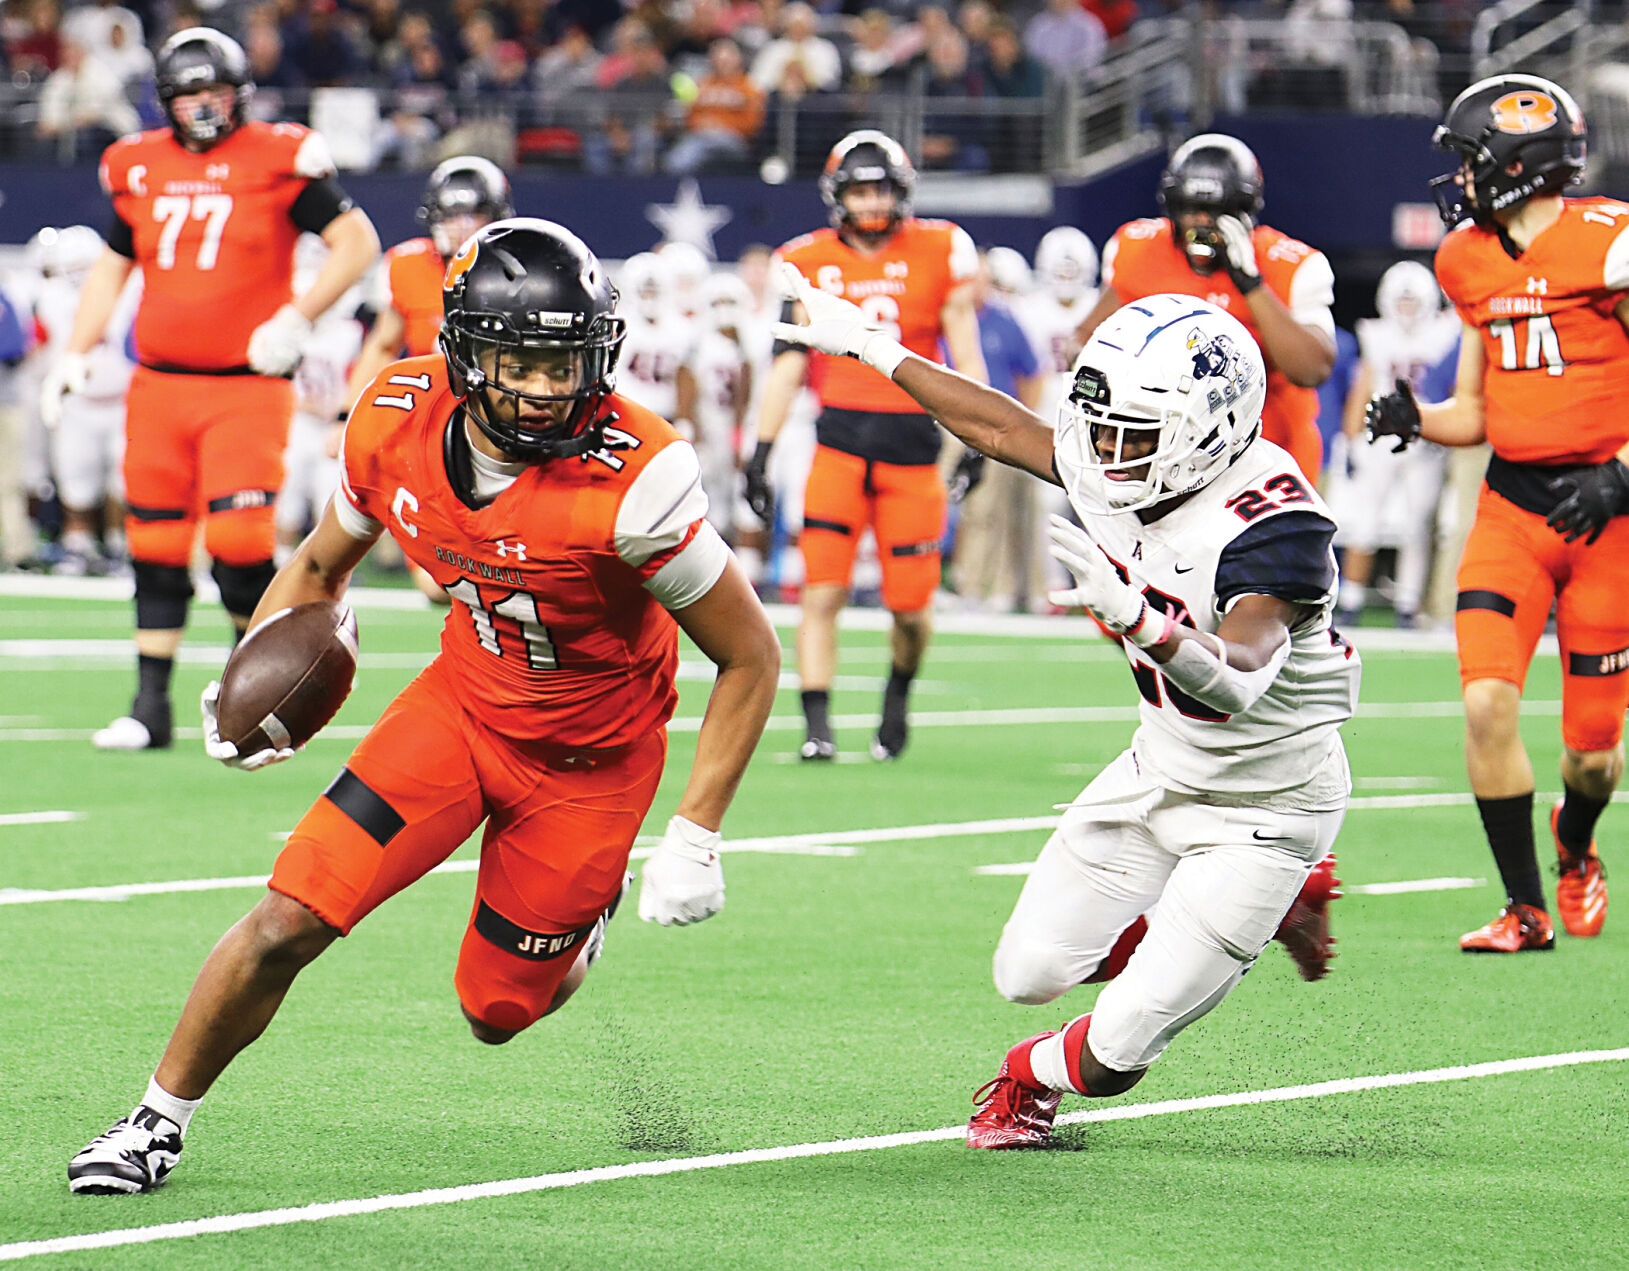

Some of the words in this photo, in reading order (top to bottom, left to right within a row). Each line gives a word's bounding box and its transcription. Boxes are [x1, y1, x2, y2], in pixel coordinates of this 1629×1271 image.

[127, 164, 148, 197] C
[152, 195, 233, 270] 77
[1490, 297, 1543, 314] ROCKWALL
[1488, 314, 1565, 376] 14
[373, 373, 432, 411] 11
[392, 487, 419, 538] C
[1224, 472, 1315, 523] 23
[434, 545, 527, 586] ROCKWALL
[1131, 540, 1144, 561] A
[442, 576, 561, 670] 11
[518, 932, 577, 954] JFND
